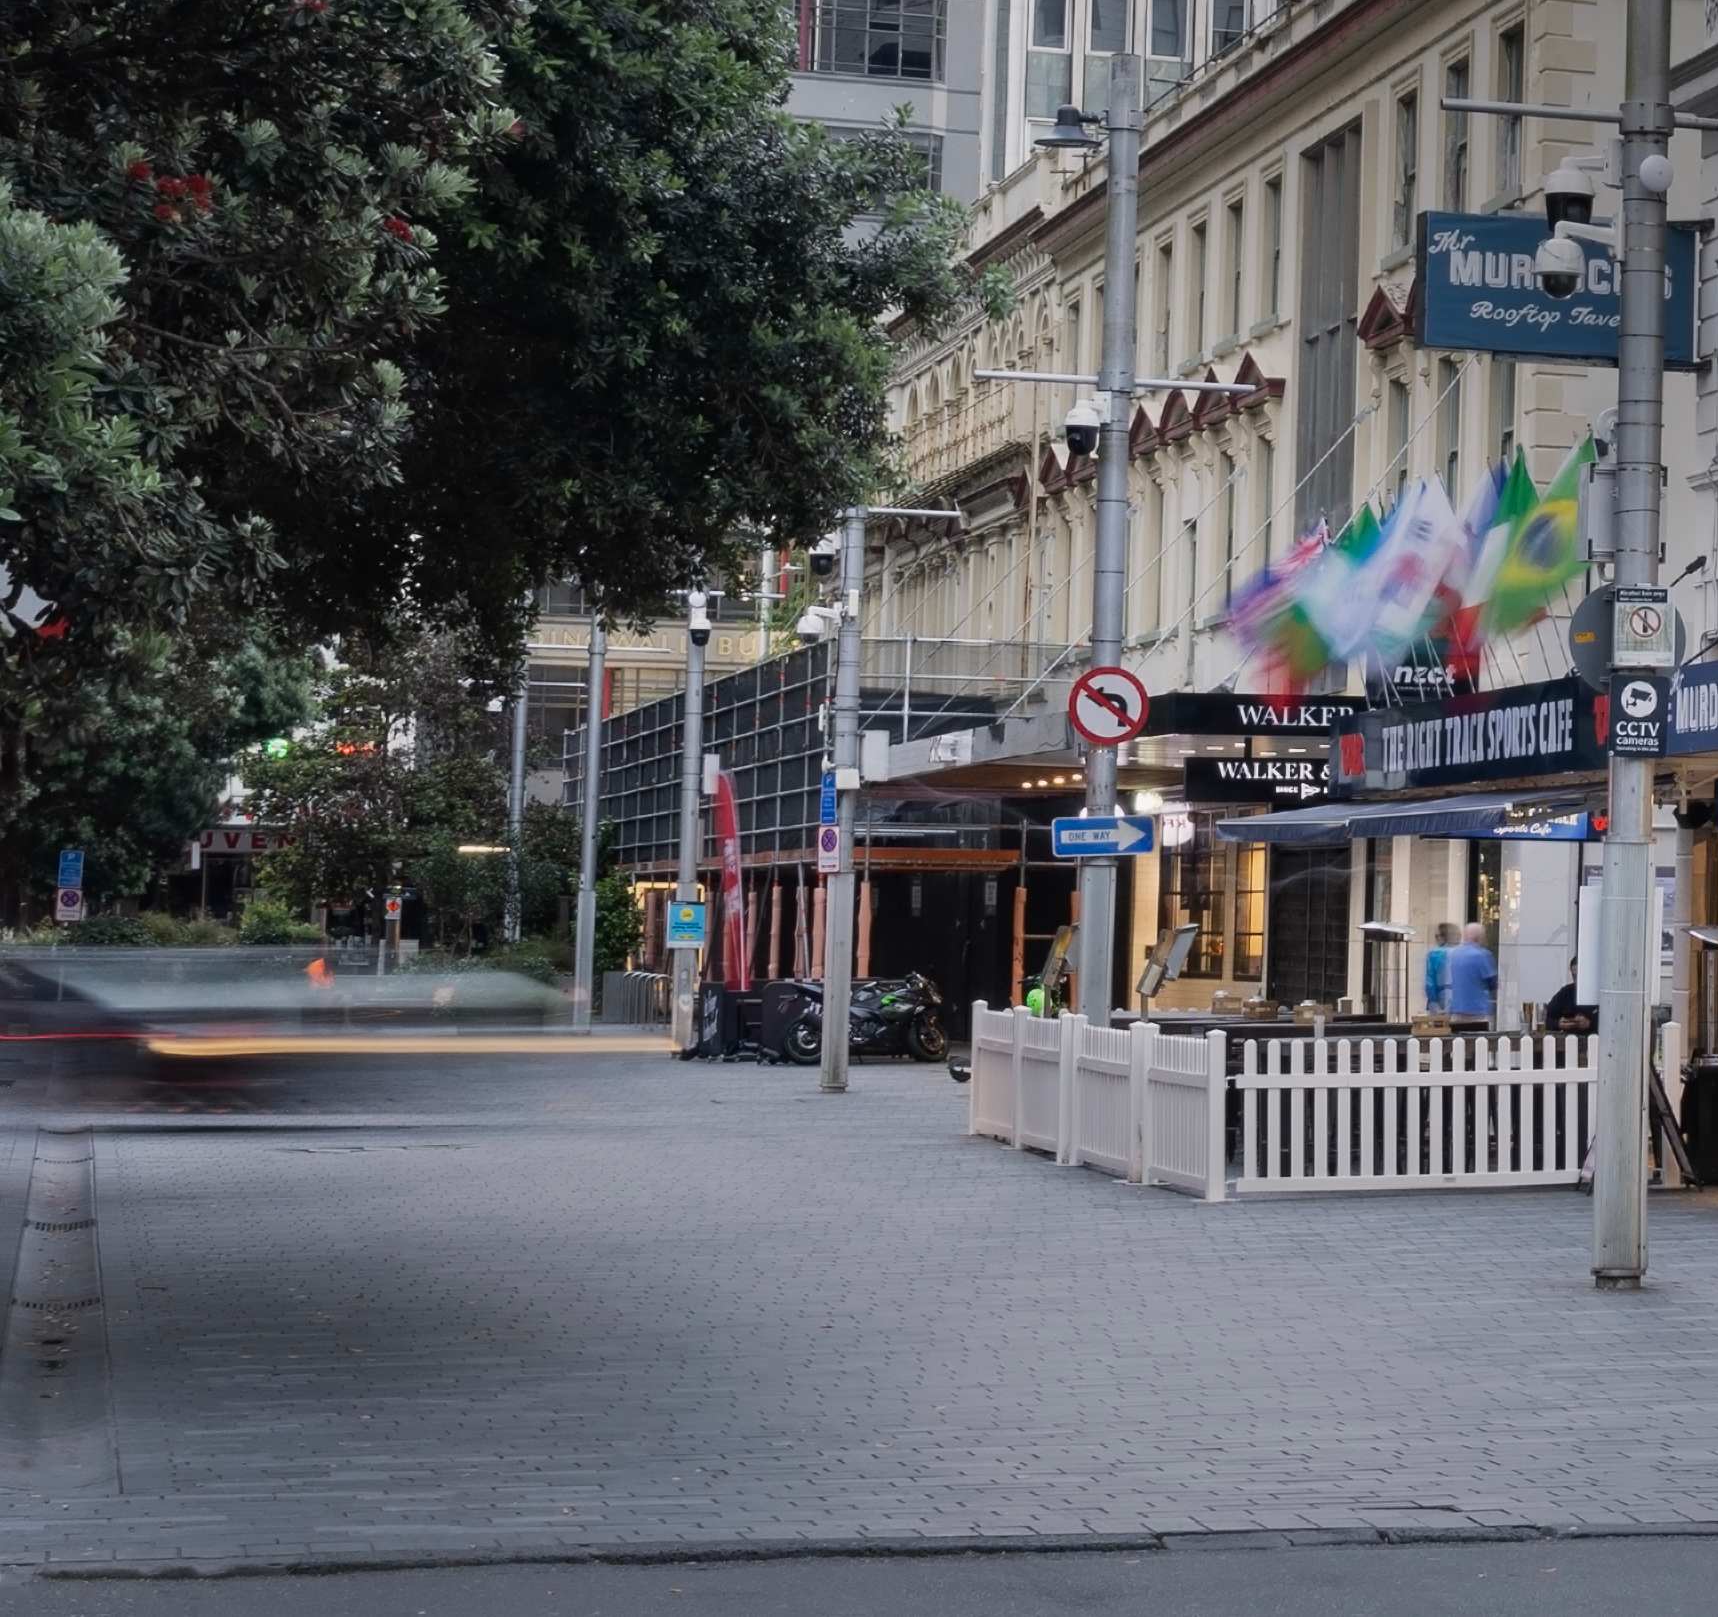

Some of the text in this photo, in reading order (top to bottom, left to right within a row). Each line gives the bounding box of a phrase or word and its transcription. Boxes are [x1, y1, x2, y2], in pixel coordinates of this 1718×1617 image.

[1470, 300, 1622, 332] Rooftop Tave
[1382, 725, 1405, 773] THE
[1406, 719, 1442, 771] RIGHT
[1445, 711, 1485, 765] TRACK
[1487, 703, 1536, 761] SPORTS
[1539, 698, 1574, 755] CAFE
[1616, 721, 1660, 737] CCTV
[1616, 737, 1659, 745] cameras
[1218, 761, 1314, 780] WALKER
[1068, 831, 1111, 841] ONE WAY
